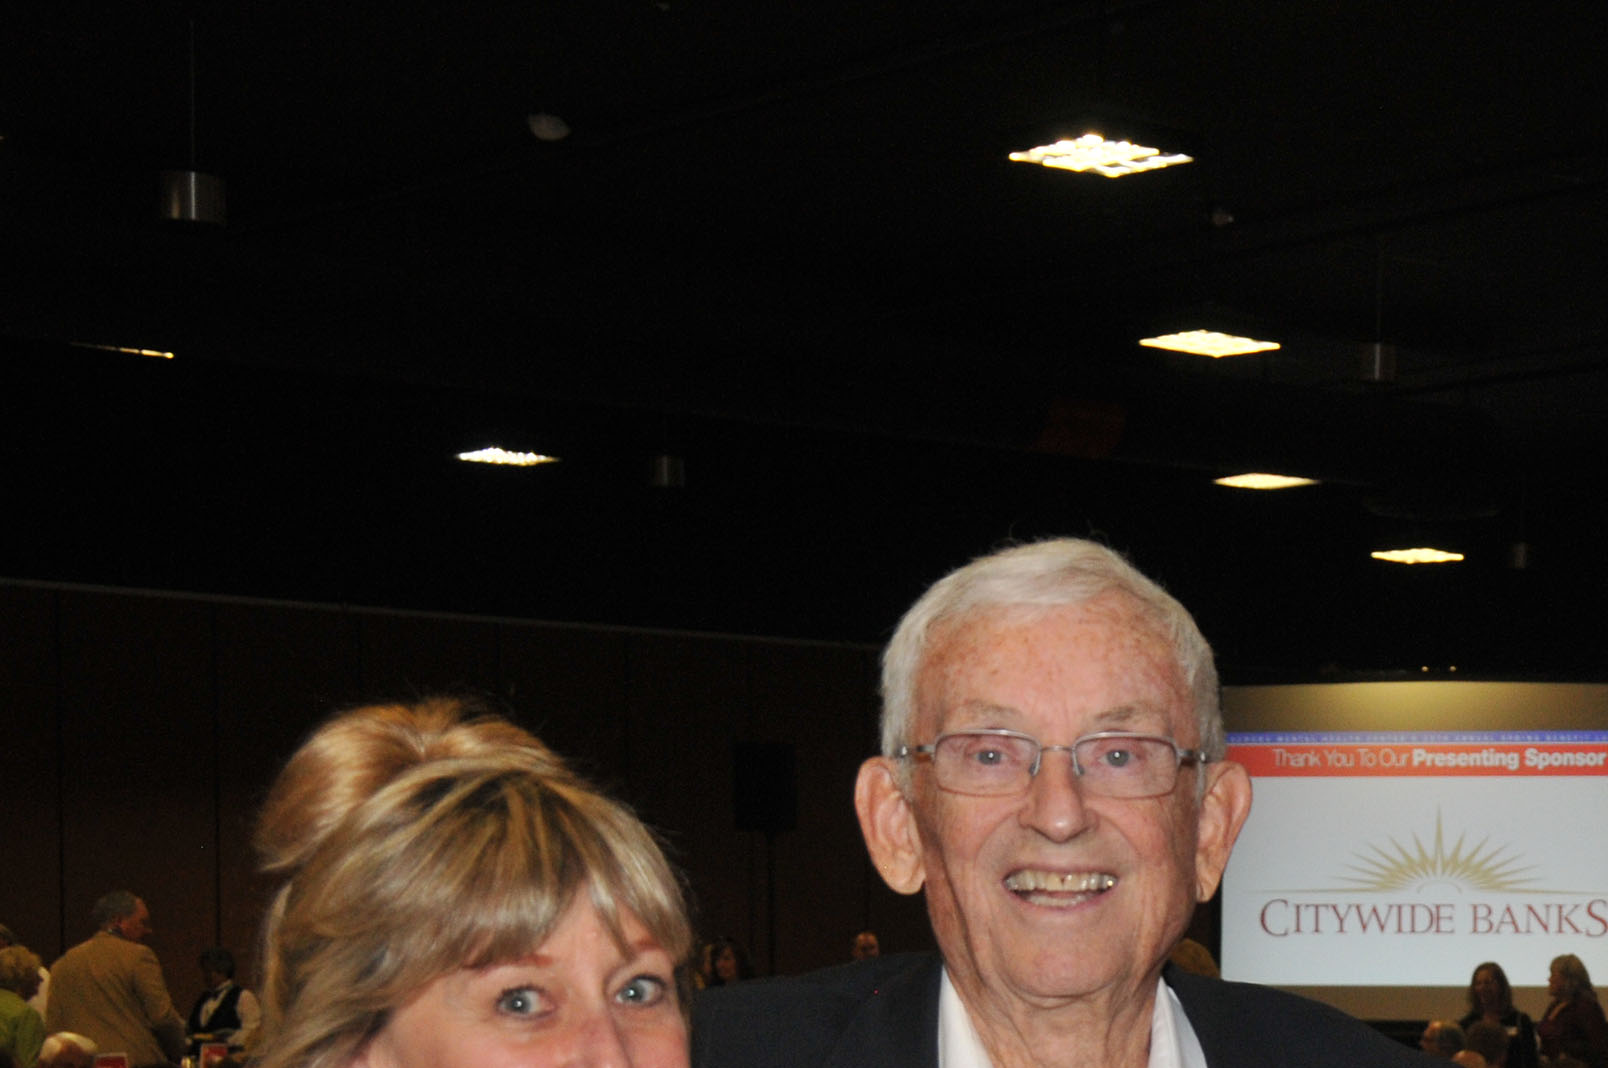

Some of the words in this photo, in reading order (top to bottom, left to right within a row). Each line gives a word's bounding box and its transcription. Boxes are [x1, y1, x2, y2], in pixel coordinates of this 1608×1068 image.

[1273, 748, 1321, 768] Thank
[1322, 748, 1355, 768] You
[1357, 748, 1377, 767] To
[1379, 748, 1409, 767] Our
[1412, 748, 1519, 770] Presenting
[1524, 748, 1607, 769] Sponsor
[1259, 898, 1456, 938] CITYWIDE
